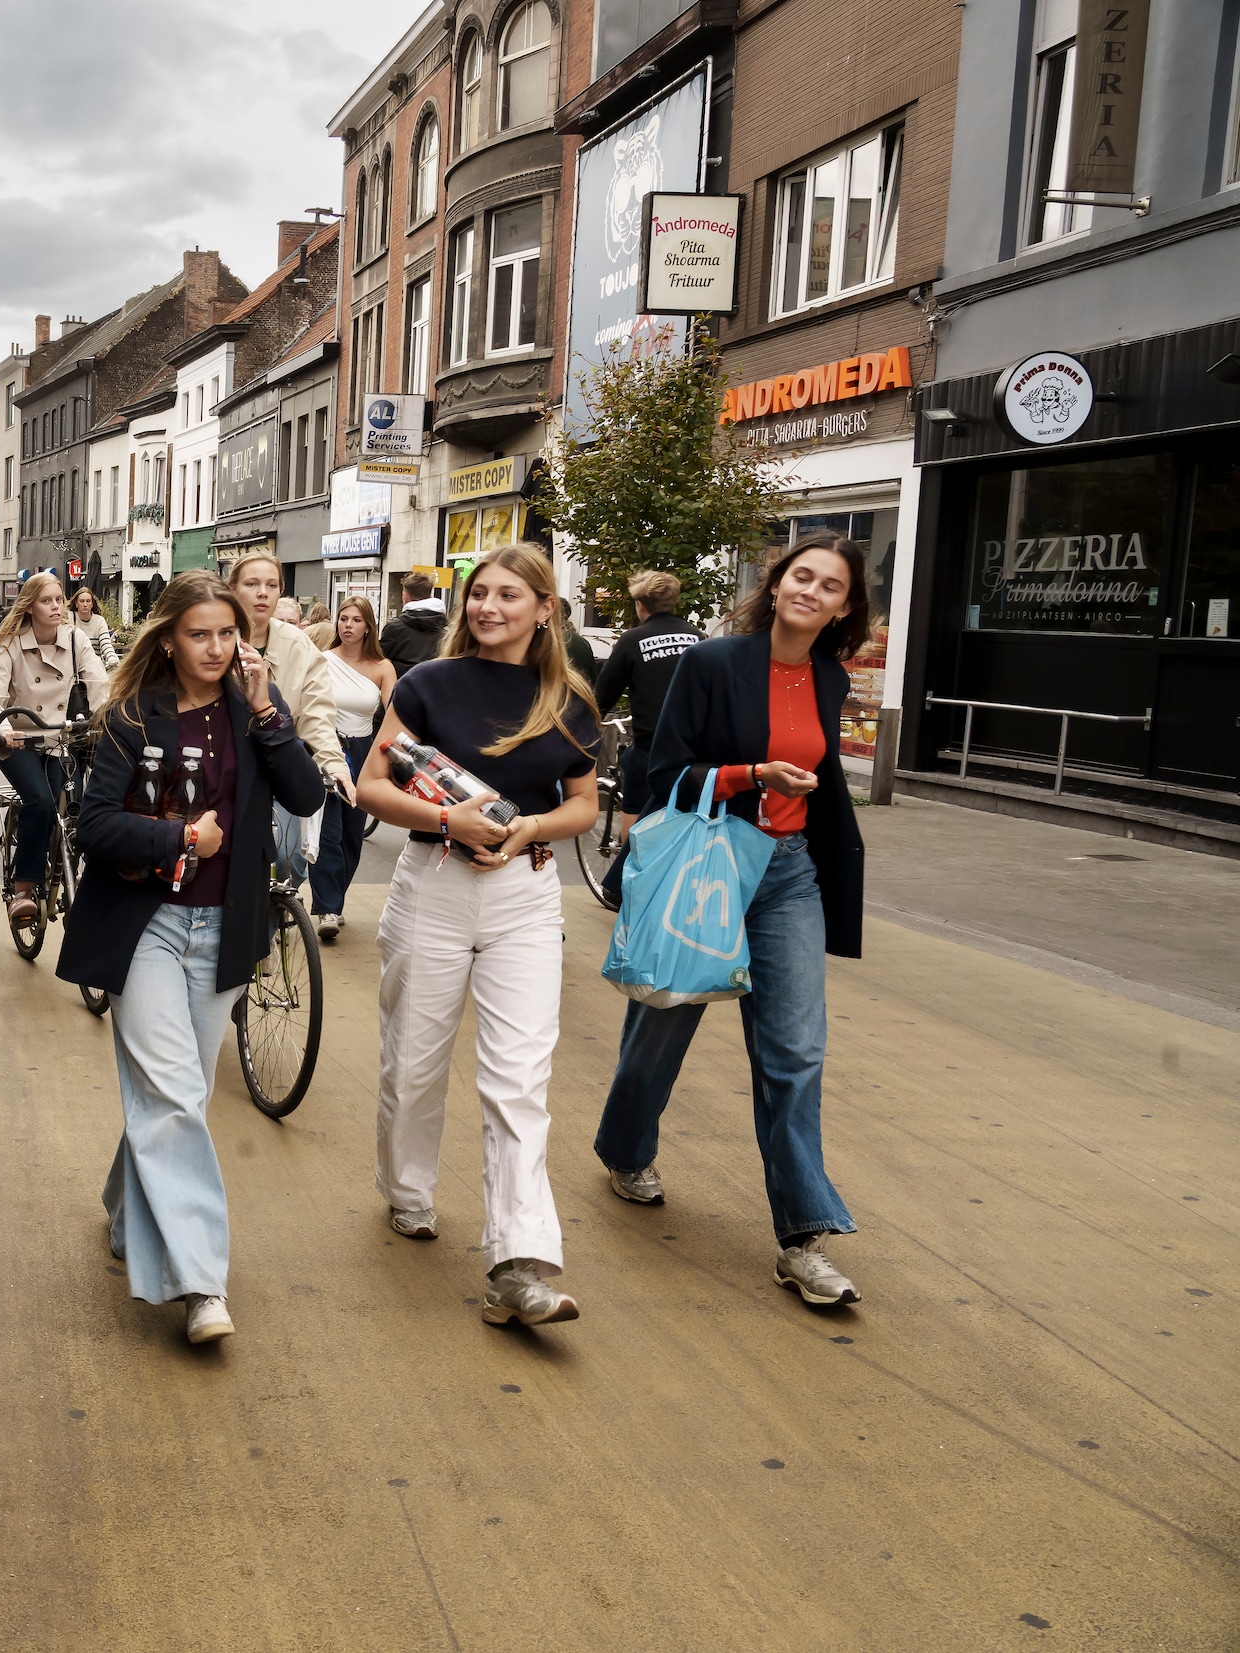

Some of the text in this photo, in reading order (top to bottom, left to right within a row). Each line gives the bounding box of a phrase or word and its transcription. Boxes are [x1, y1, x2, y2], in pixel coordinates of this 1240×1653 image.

[653, 216, 736, 239] Andromeda
[680, 239, 706, 254] Pita
[664, 252, 721, 266] Shoarma
[669, 273, 715, 288] Frituur
[595, 317, 635, 346] coming
[719, 346, 912, 425] ANDROMEDA
[1013, 362, 1084, 393] Prima Donna
[369, 406, 402, 420] ALL
[366, 440, 412, 451] Services
[367, 430, 408, 443] Printing
[365, 465, 391, 473] MISTER
[449, 464, 512, 495] MISTER COPY
[322, 530, 379, 556] CYBER HOUSE GENT
[983, 532, 1147, 574] PIZZERIA
[982, 562, 1145, 604] Primadonna
[1006, 610, 1074, 621] ZITPLAATSEN
[1084, 612, 1122, 621] AIRCO
